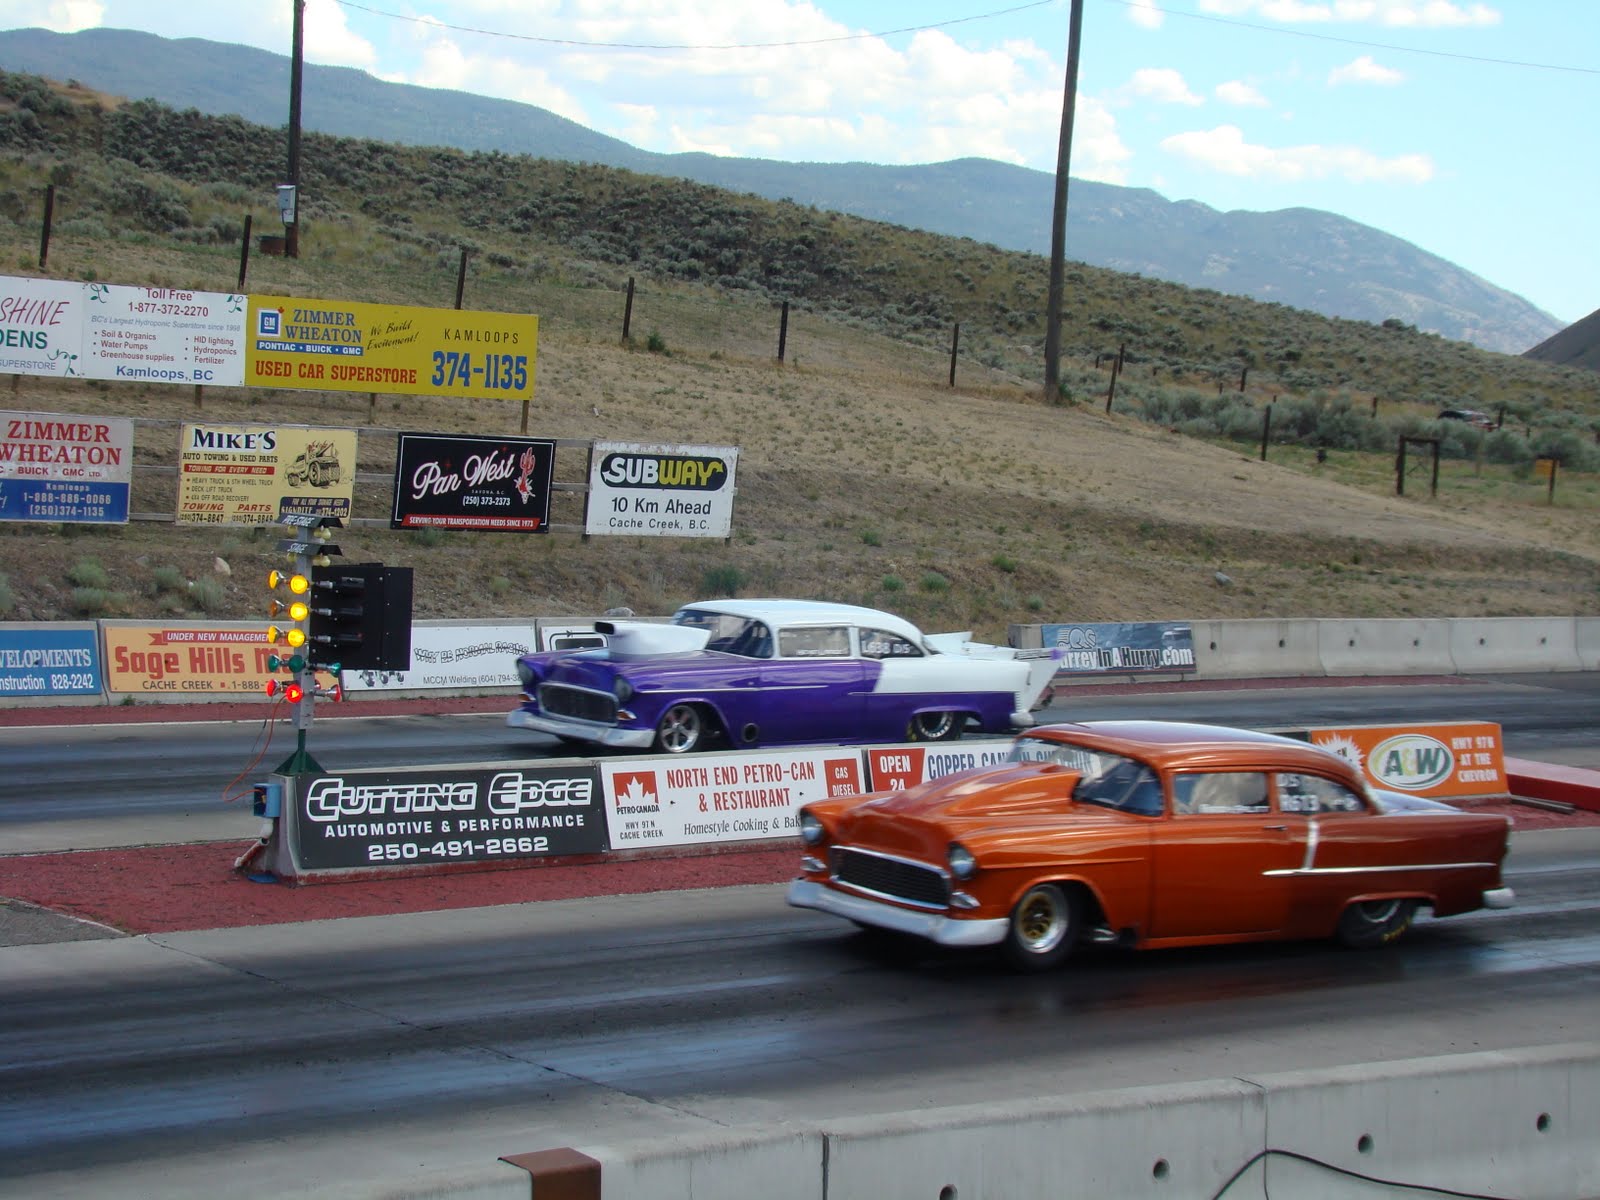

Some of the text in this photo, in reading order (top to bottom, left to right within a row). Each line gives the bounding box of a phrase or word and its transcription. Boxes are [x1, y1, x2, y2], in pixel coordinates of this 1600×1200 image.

[146, 288, 192, 301] Toll Free
[0, 297, 70, 325] SHINE
[128, 302, 208, 317] 1-877-372-2270
[110, 317, 133, 326] Largest
[135, 318, 171, 328] Hydroponic
[172, 321, 206, 330] Superstore
[264, 317, 275, 326] GM
[293, 309, 356, 326] ZIMMER
[285, 326, 362, 343] WHEATON
[370, 320, 412, 336] We Build
[101, 330, 156, 341] Soil & Organics
[194, 336, 234, 346] HID lighting
[367, 332, 420, 350] Excitement!
[444, 328, 519, 344] KAMLOOPS
[100, 340, 148, 350] Water Pumps
[194, 346, 237, 356] Hydroponics
[260, 342, 361, 355] PONTIAC BUICK GMC
[100, 350, 174, 362] Greenhouse supplies
[194, 356, 225, 364] Fertilizer
[193, 370, 214, 380] BC
[256, 360, 417, 384] USED CAR SUPERSTORE
[432, 350, 528, 390] 374-1135
[8, 420, 110, 442] ZIMMER
[192, 428, 276, 450] MIKE'S
[0, 443, 122, 466] WHEATON
[182, 452, 200, 460] AUTO
[232, 454, 236, 462] &
[18, 467, 49, 476] BUICK
[62, 468, 84, 476] GMC
[412, 450, 516, 500] Pan West
[602, 457, 724, 486] SUBWAY
[46, 483, 90, 492] Kamloops
[182, 502, 224, 511] TOWING
[462, 496, 510, 506] (250) 373-2373
[612, 497, 712, 514] 10 Km Ahead
[238, 504, 272, 512] PARTS
[410, 516, 431, 524] SERVING
[448, 518, 490, 526] TRANSPORTATION
[609, 517, 710, 530] Cache Creek, B.C.
[167, 632, 269, 642] UNDER NEW MANAGEME
[414, 641, 530, 663] WHY BE NORMAL RACING
[1061, 646, 1194, 669] urreyInAHurry.com
[115, 646, 180, 679] Sage
[189, 646, 245, 674] Hills
[52, 674, 94, 690] 828-2242
[142, 680, 213, 690] CACHE CREEK
[448, 676, 477, 684] Welding
[478, 674, 496, 684] (604)
[880, 755, 911, 774] OPEN
[1384, 748, 1441, 777] A&W
[1460, 753, 1492, 766] AT THE
[666, 761, 816, 789] NORTH END PETRO-CAN
[834, 766, 848, 779] GAS
[1458, 769, 1498, 782] CHEVRON
[832, 784, 856, 796] DIESEL
[890, 778, 906, 791] 24
[306, 772, 593, 822] CUTTING EDGE
[699, 788, 790, 812] & RESTAURANT
[325, 814, 585, 838] AUTOMOTIVE & PERFORMANCE
[625, 820, 656, 830] HWY 97 N
[684, 816, 801, 836] Homestyle Cooking & Bak
[620, 830, 664, 840] CACHE CREEK
[368, 836, 549, 860] 250-491-2662
